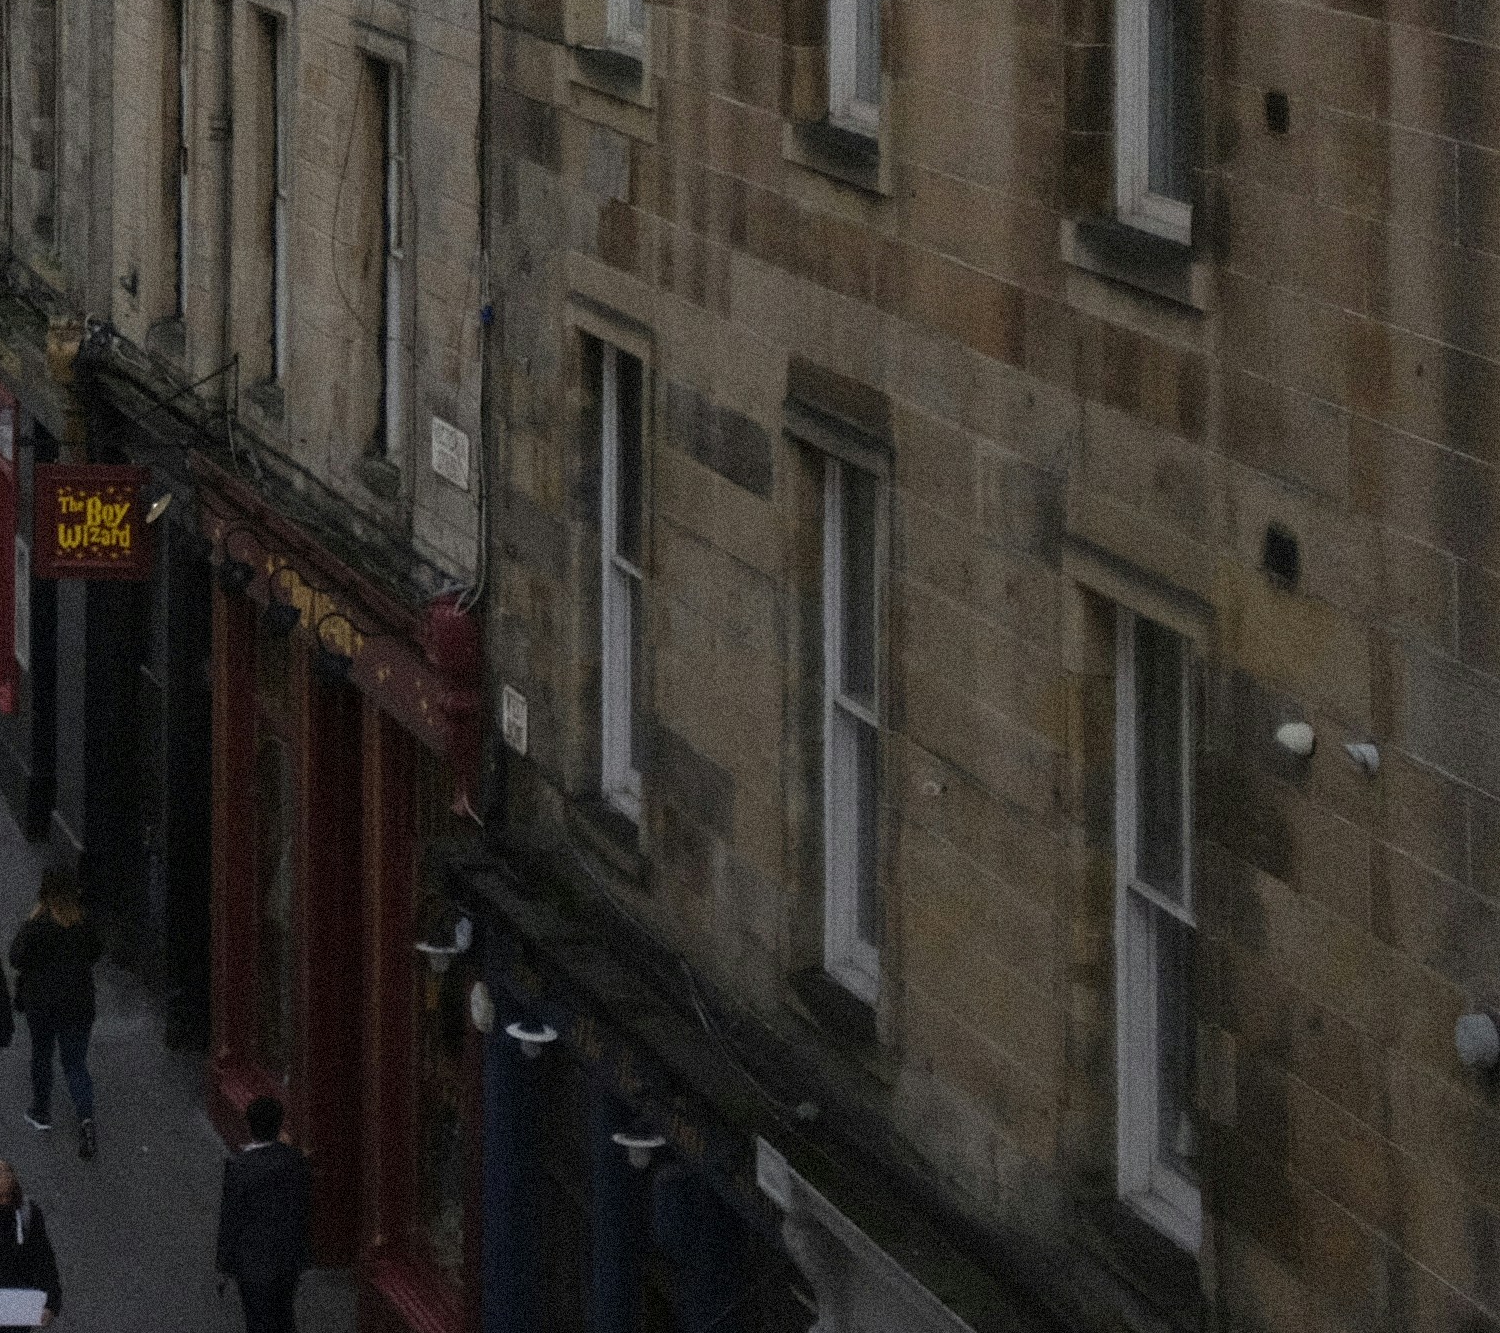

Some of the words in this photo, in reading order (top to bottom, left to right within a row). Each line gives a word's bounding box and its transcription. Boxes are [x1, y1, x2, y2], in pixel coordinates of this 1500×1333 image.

[58, 496, 85, 514] The
[86, 496, 130, 528] Boy
[58, 524, 131, 549] Wizard
